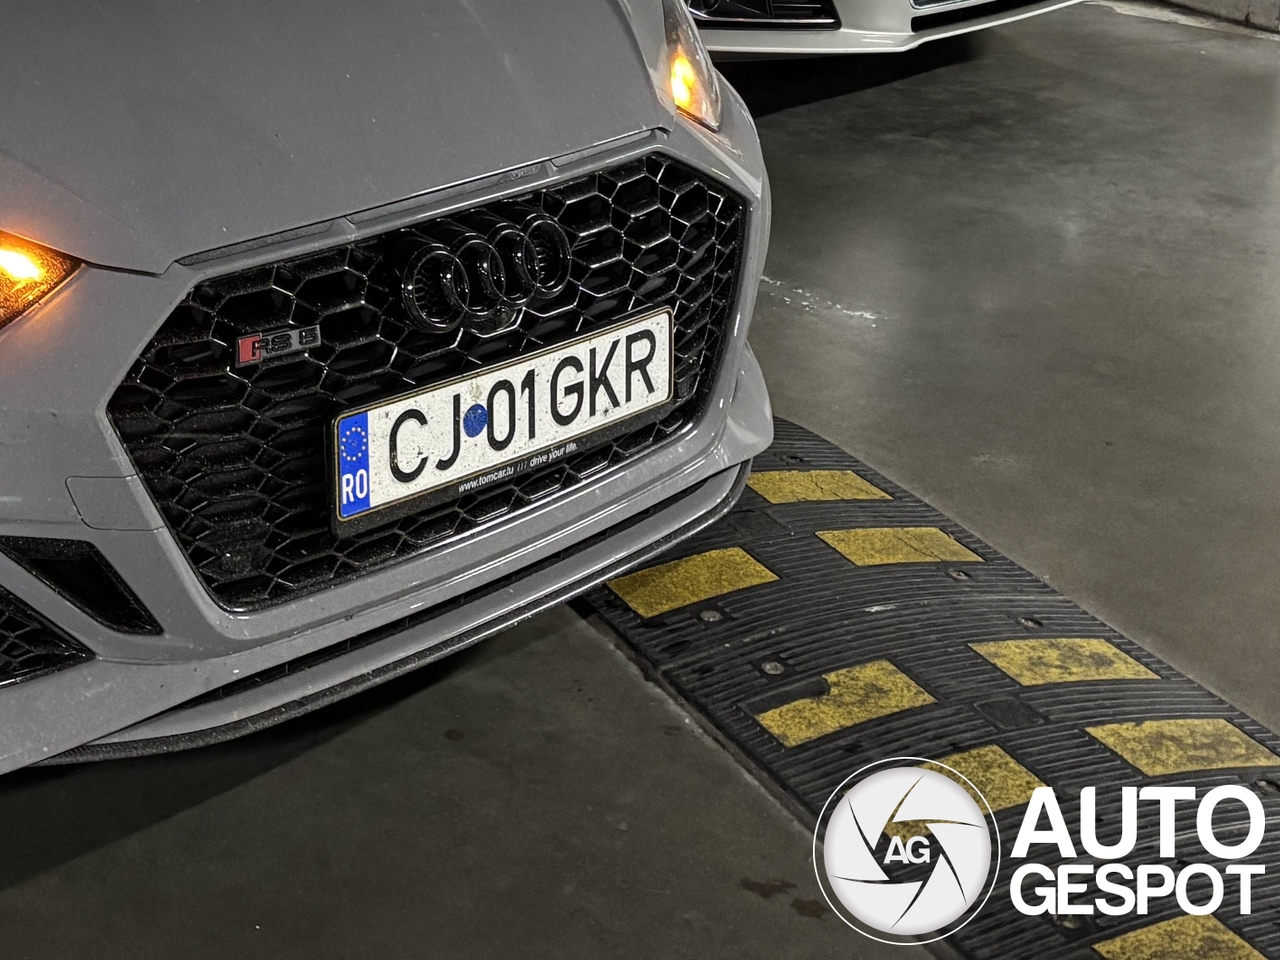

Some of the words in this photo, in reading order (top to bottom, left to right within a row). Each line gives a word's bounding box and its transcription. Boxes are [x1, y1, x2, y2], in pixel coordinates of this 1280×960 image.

[342, 469, 368, 505] RO
[389, 393, 461, 483] CJ
[530, 455, 548, 467] drive
[548, 447, 565, 462] your
